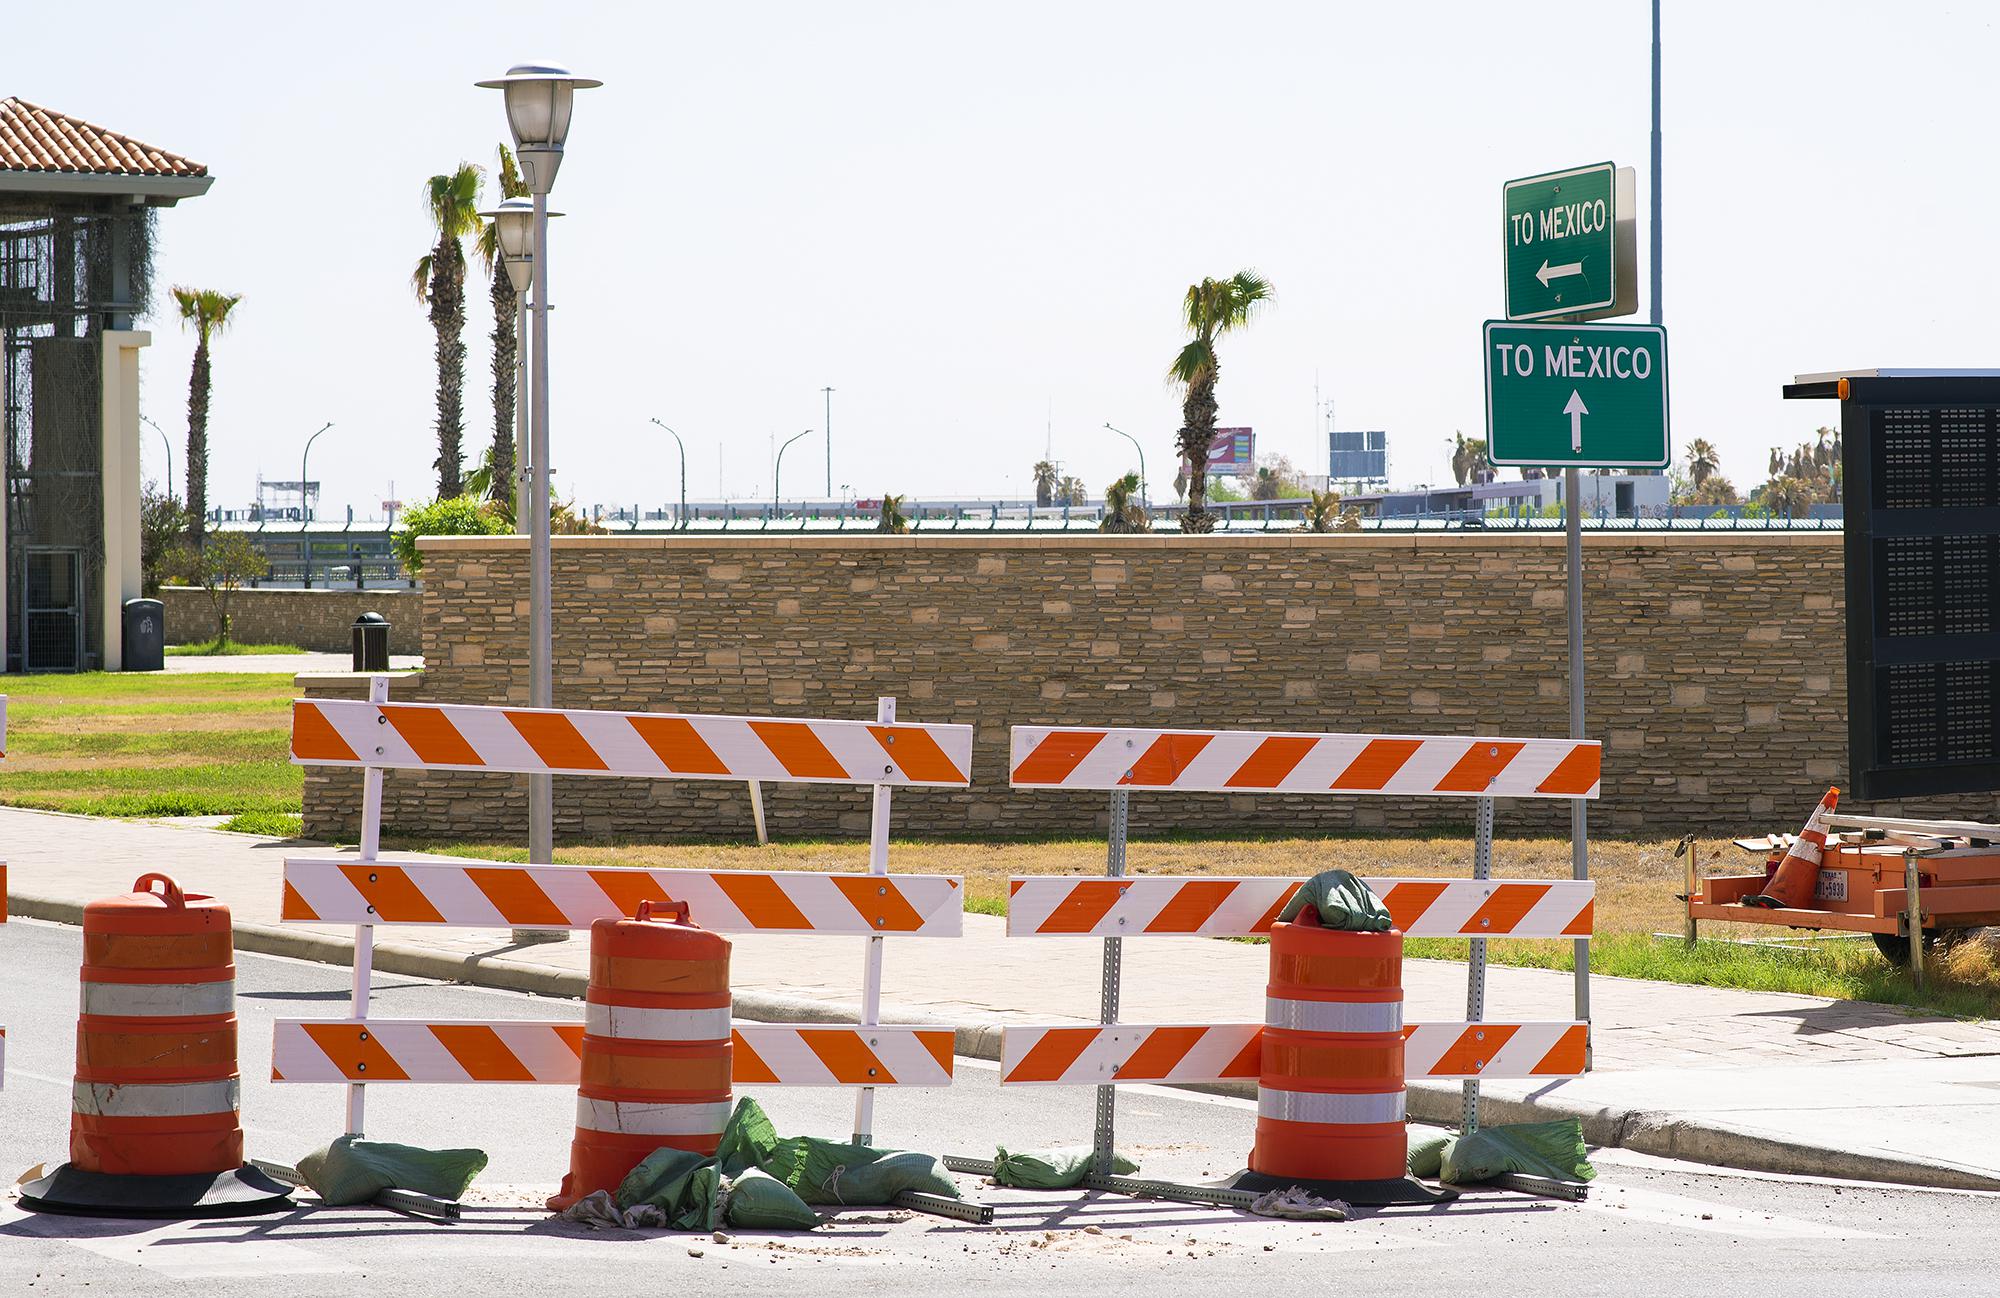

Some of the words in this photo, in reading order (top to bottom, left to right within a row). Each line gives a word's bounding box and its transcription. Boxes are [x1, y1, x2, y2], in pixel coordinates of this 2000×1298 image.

[1512, 212, 1533, 246] TO
[1540, 199, 1605, 241] MEXICO
[1496, 344, 1534, 377] TO
